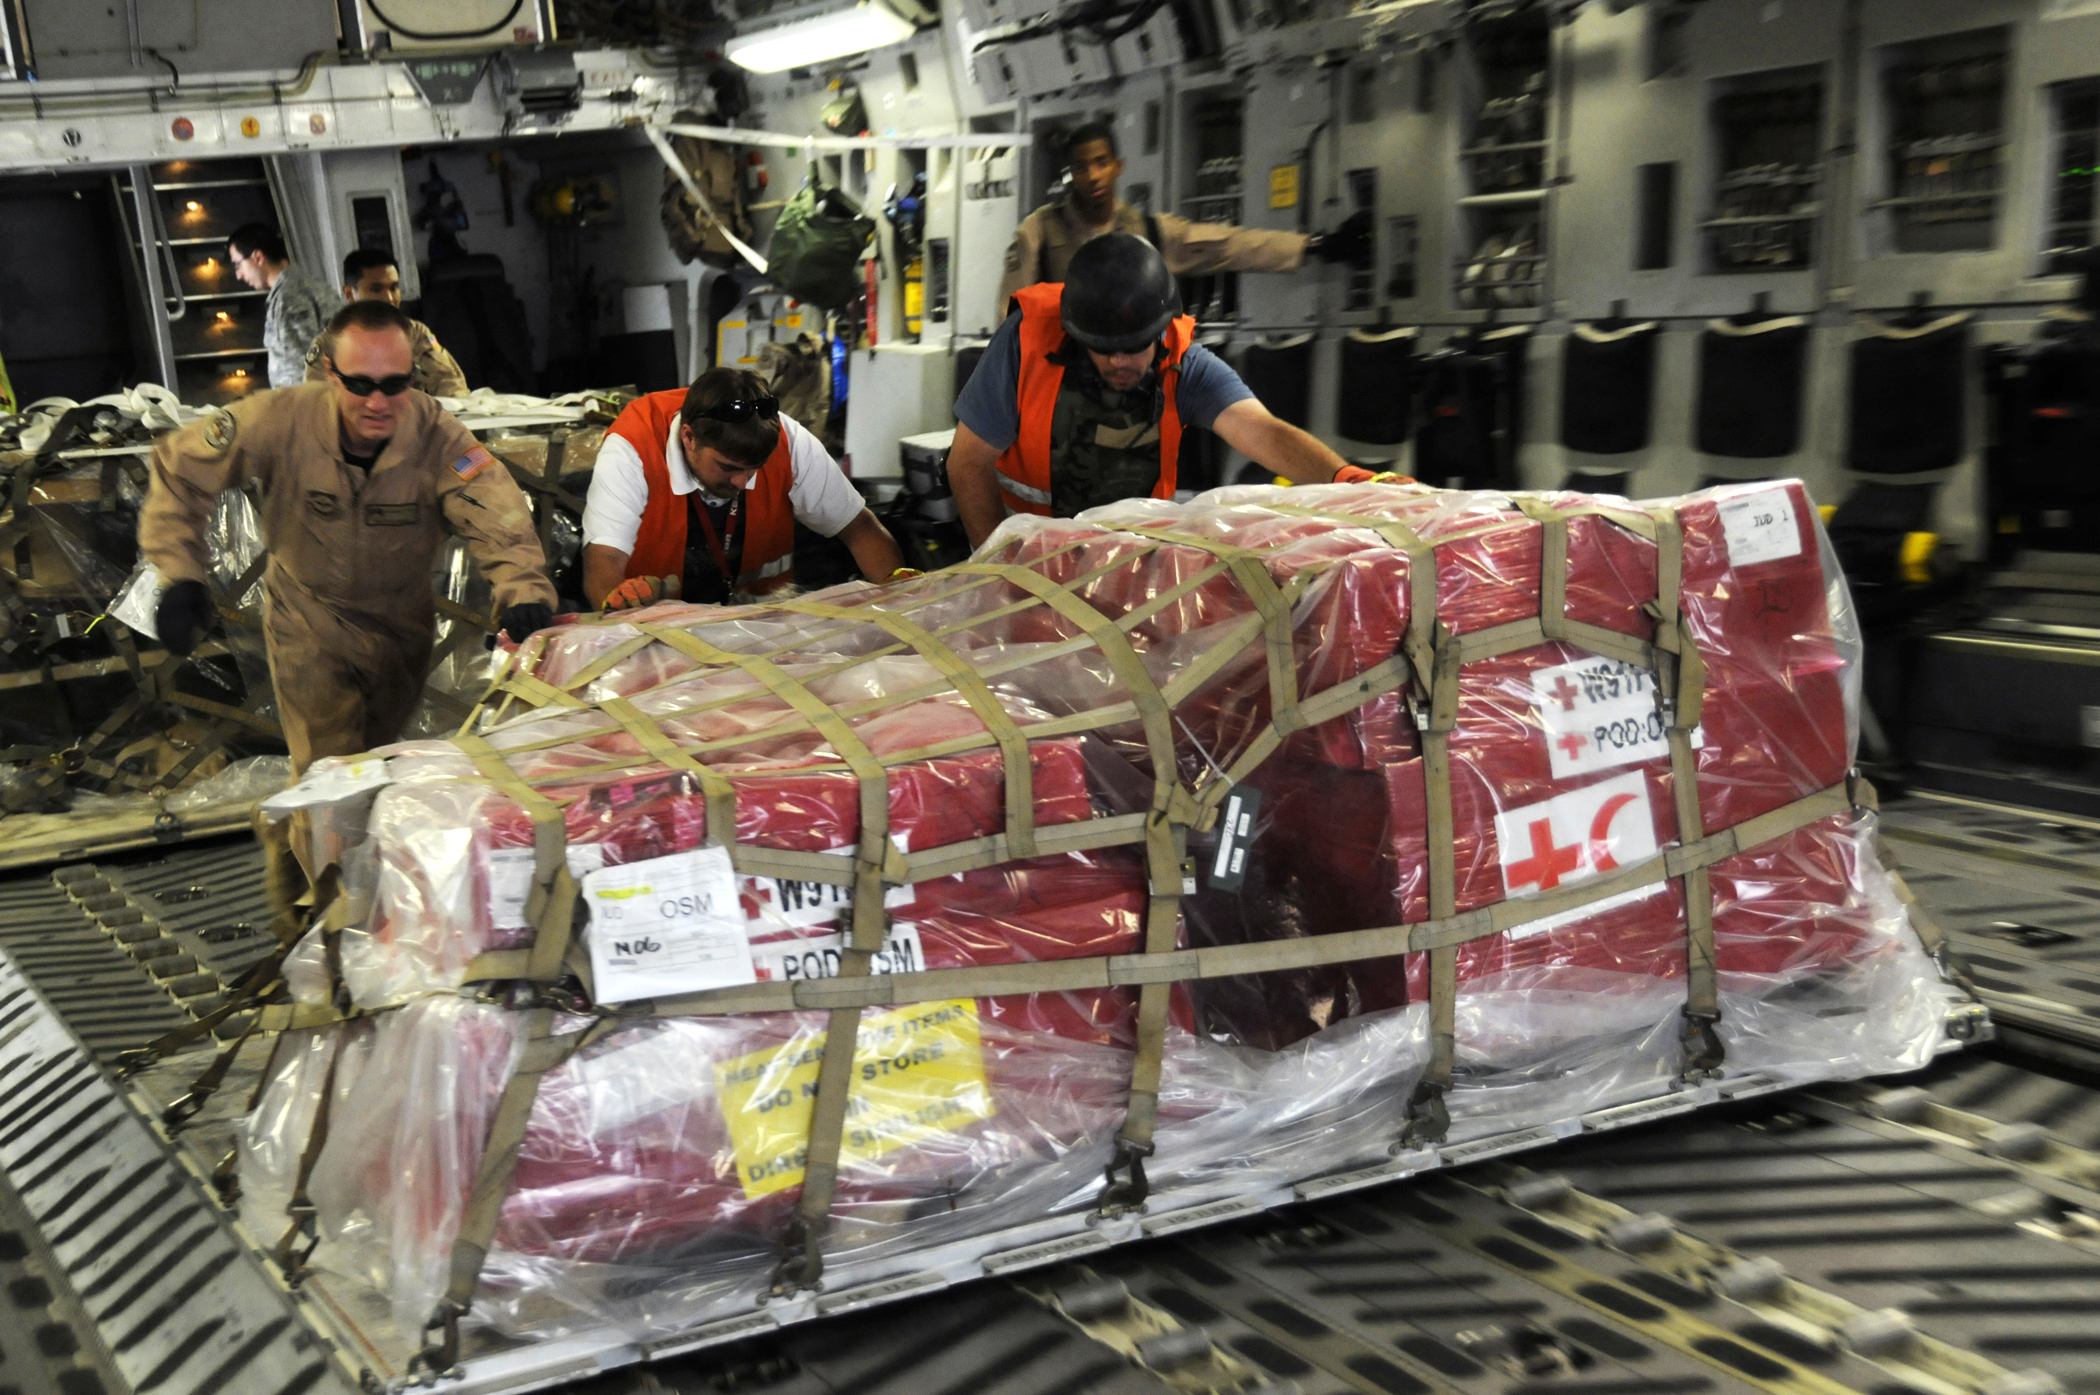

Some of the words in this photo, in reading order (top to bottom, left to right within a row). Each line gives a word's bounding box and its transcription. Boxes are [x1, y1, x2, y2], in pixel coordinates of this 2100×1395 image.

[660, 893, 713, 919] OSM
[903, 1004, 963, 1034] ITEMS
[862, 1042, 945, 1080] STORE
